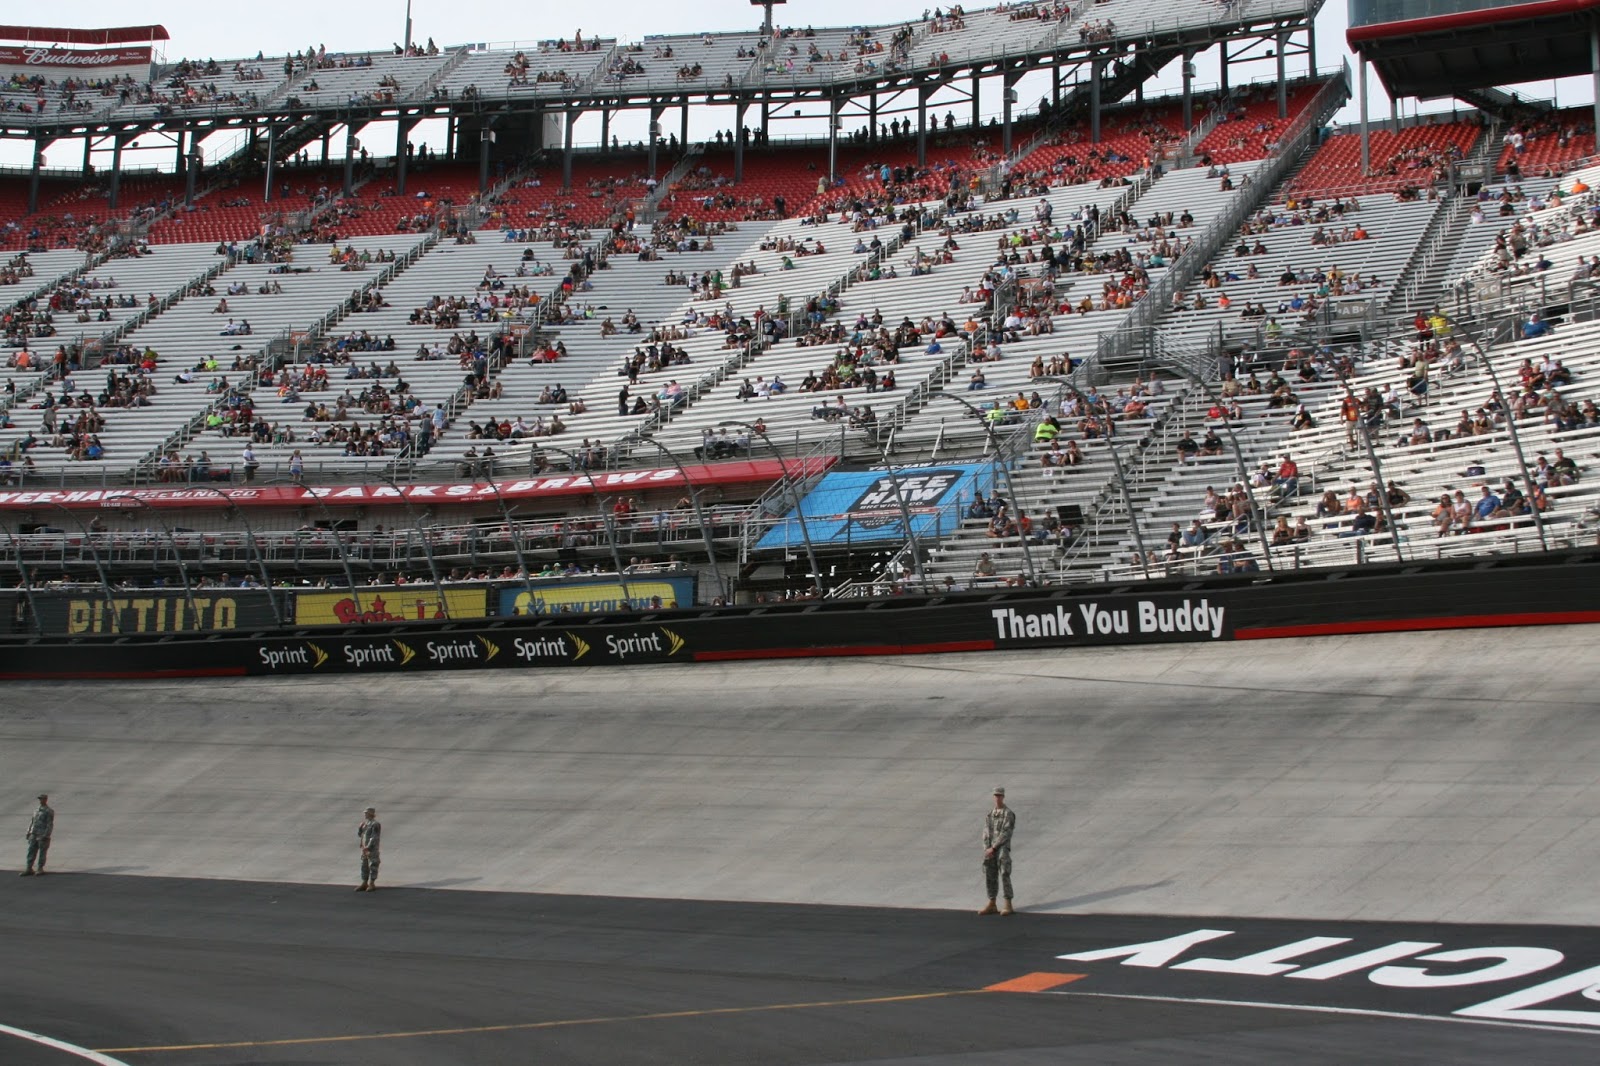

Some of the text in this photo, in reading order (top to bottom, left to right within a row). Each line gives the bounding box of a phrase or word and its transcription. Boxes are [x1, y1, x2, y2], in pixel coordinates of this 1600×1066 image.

[23, 49, 118, 65] Budweiser
[878, 474, 955, 491] YEE
[860, 487, 947, 505] HAW
[992, 599, 1225, 639] Thank You Buddy
[259, 645, 308, 668] Sprint
[344, 643, 395, 667] Sprint
[426, 639, 478, 663] Sprint
[513, 636, 567, 661] Sprint
[605, 631, 661, 659] Sprint
